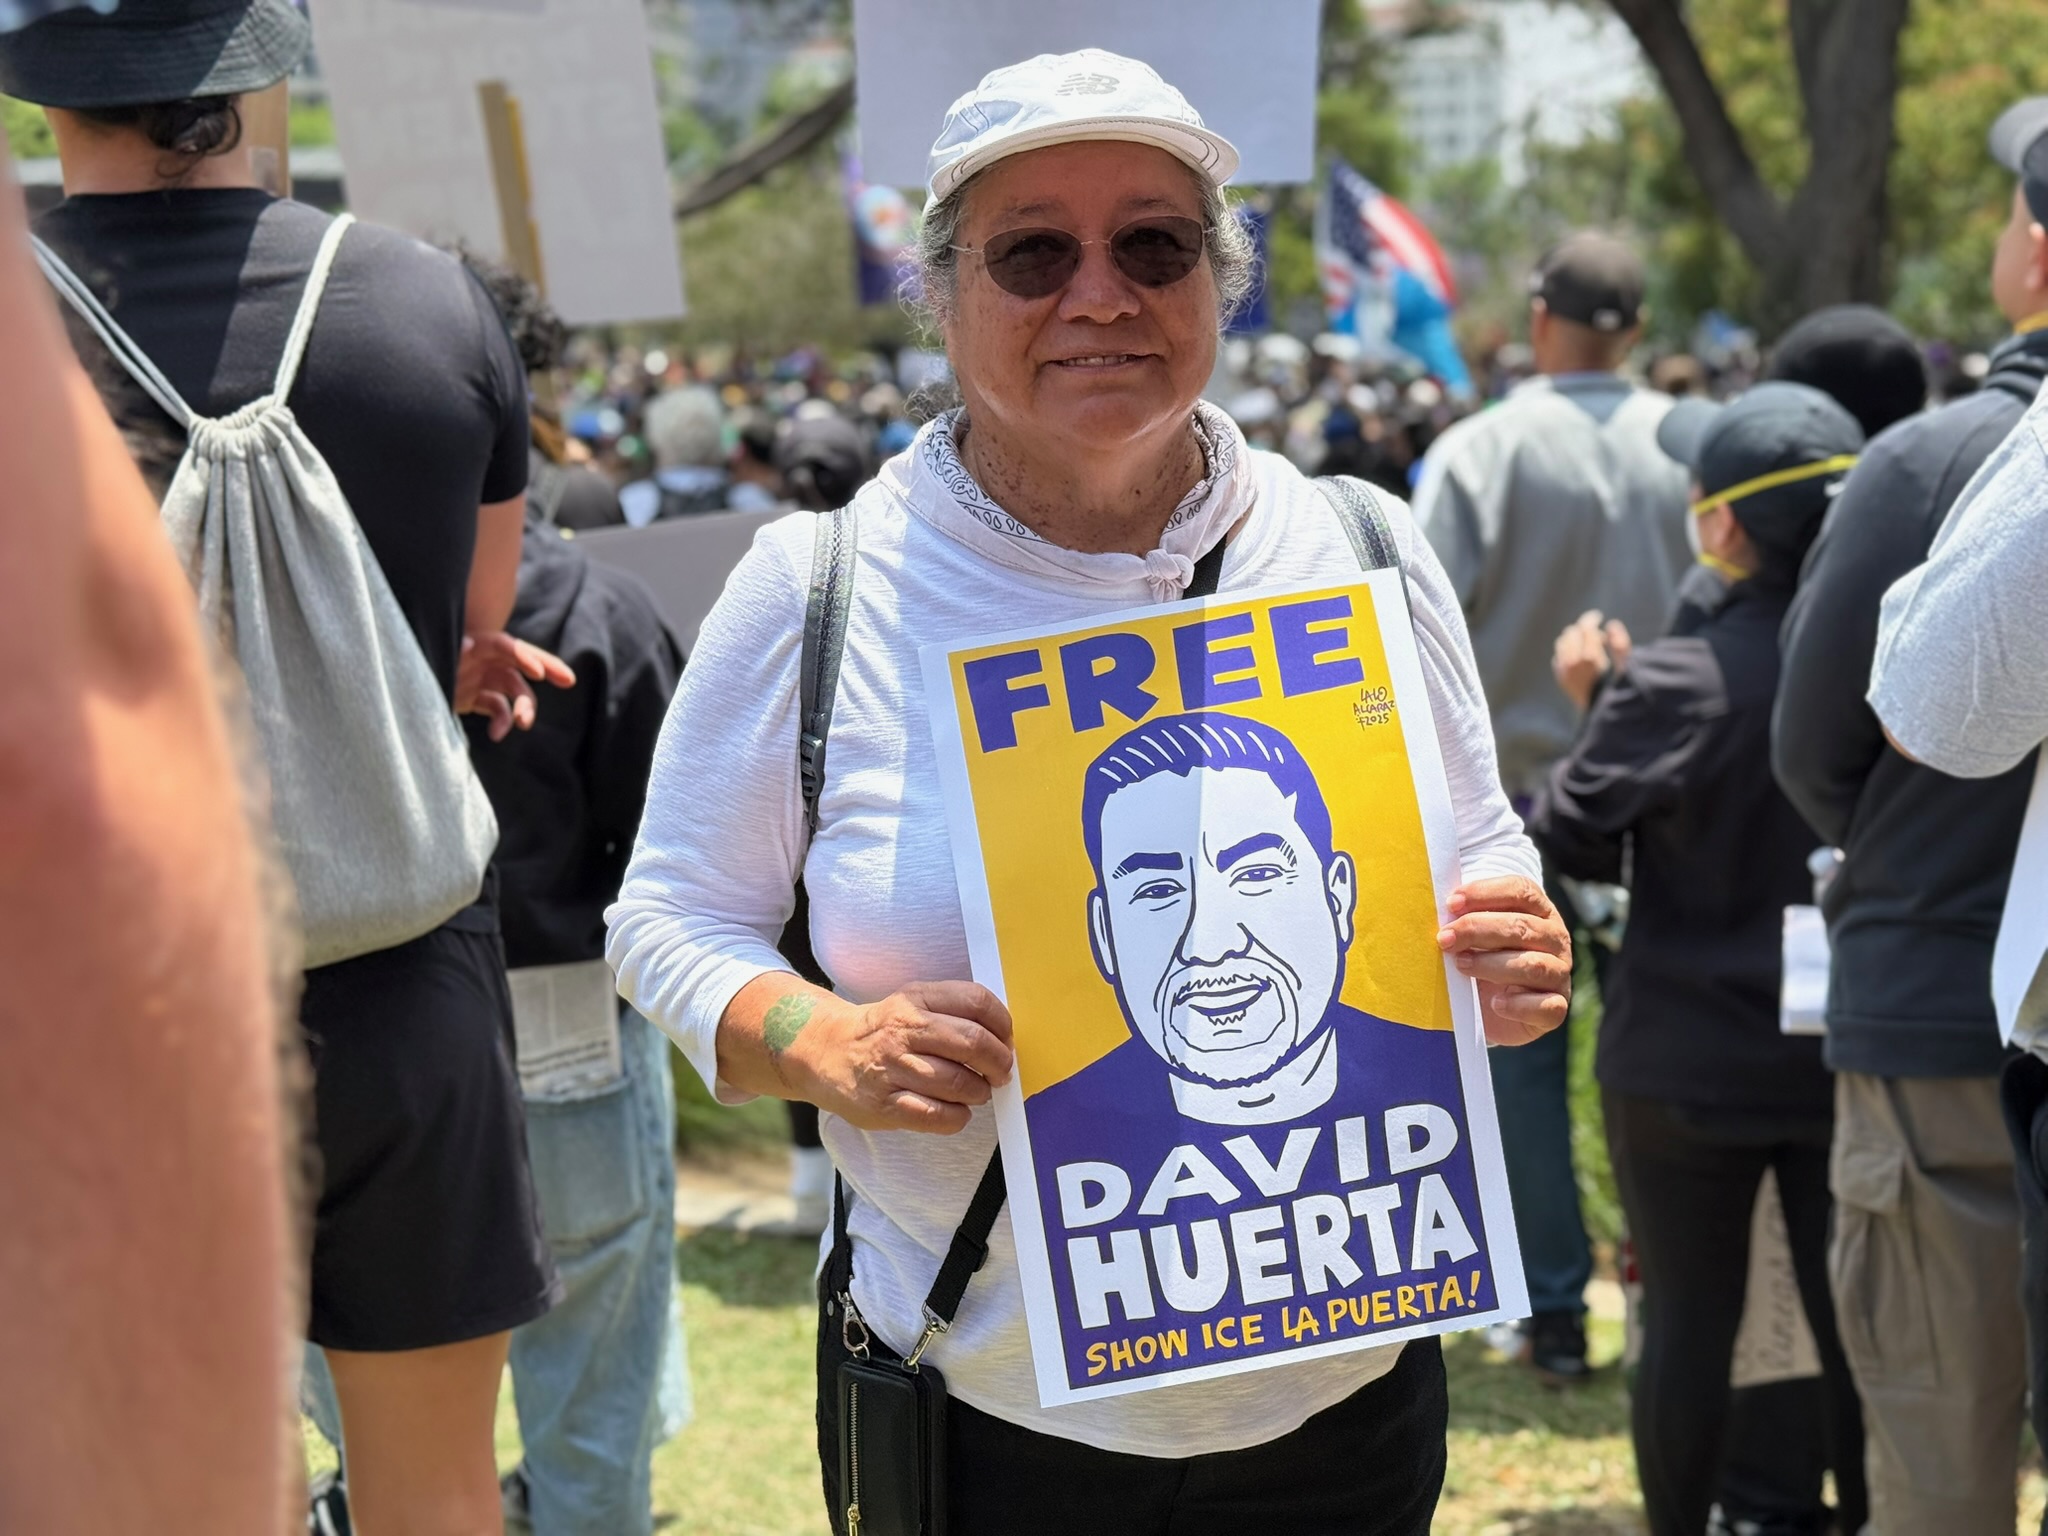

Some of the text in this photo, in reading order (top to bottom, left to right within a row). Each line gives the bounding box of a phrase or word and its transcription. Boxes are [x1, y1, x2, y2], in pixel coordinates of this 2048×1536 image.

[963, 594, 1365, 754] FREE
[1056, 1103, 1458, 1229] DAVID
[1067, 1173, 1479, 1330] HUERTA
[1086, 1270, 1481, 1377] SHOW ICE LA PUERTA!
